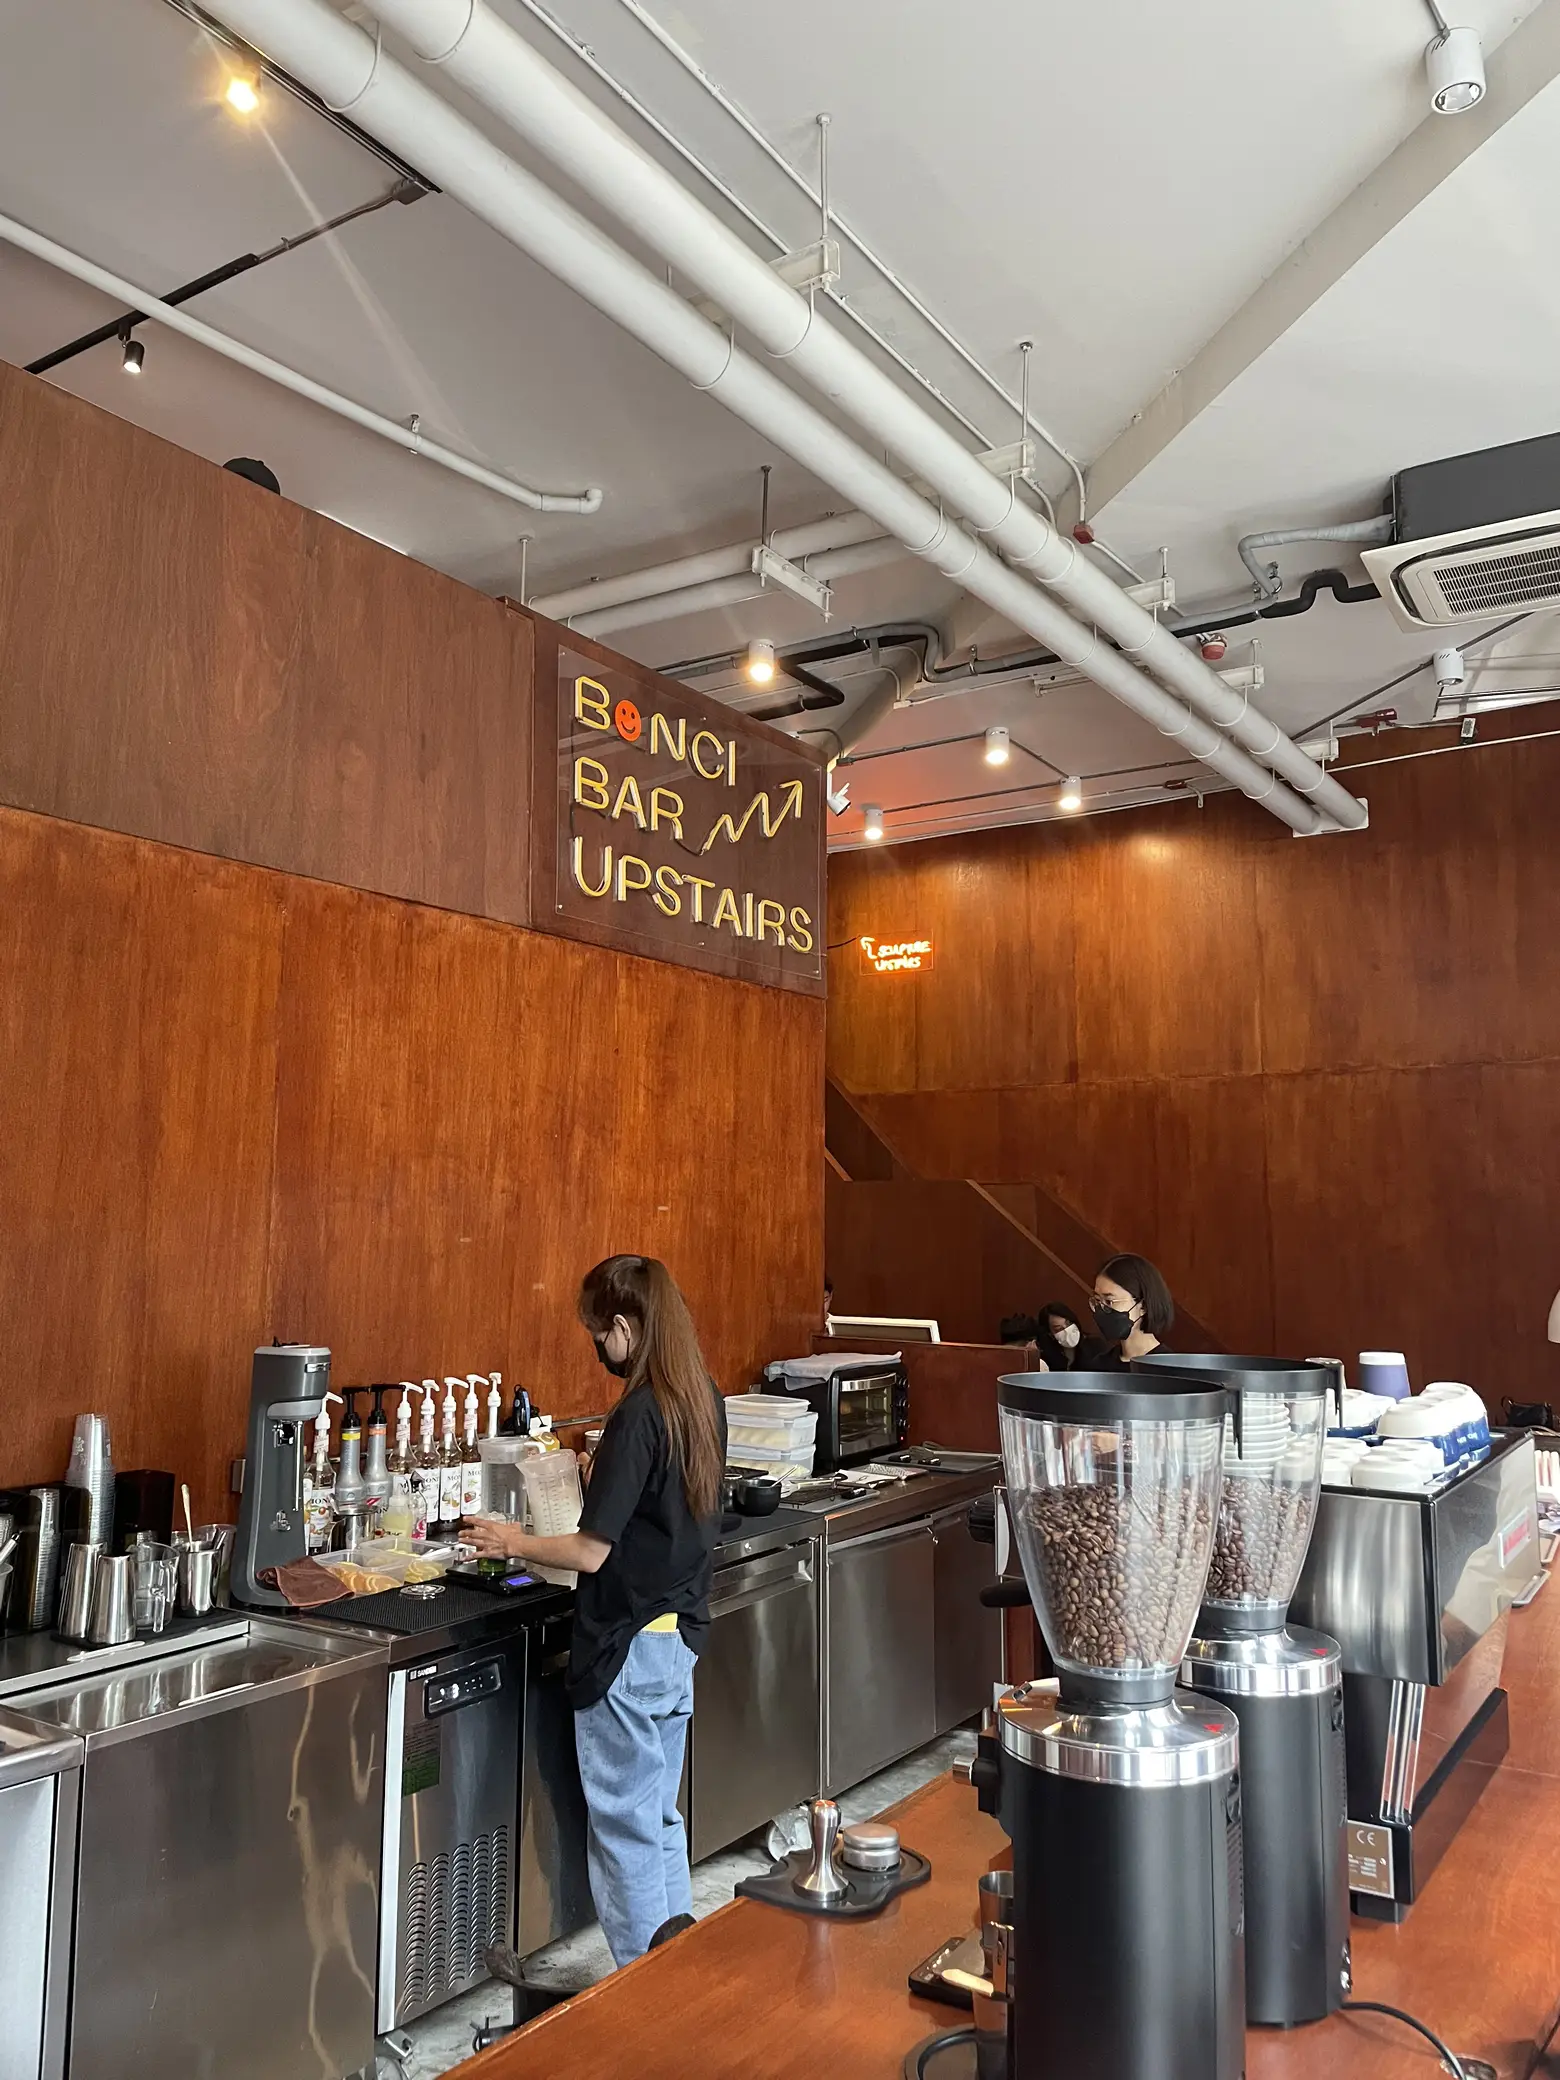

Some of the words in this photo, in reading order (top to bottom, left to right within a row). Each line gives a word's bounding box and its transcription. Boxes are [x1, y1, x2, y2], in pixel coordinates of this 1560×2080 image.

[574, 756, 684, 840] BAR
[573, 836, 813, 954] UPSTAIRS
[1356, 1829, 1376, 1846] CE
